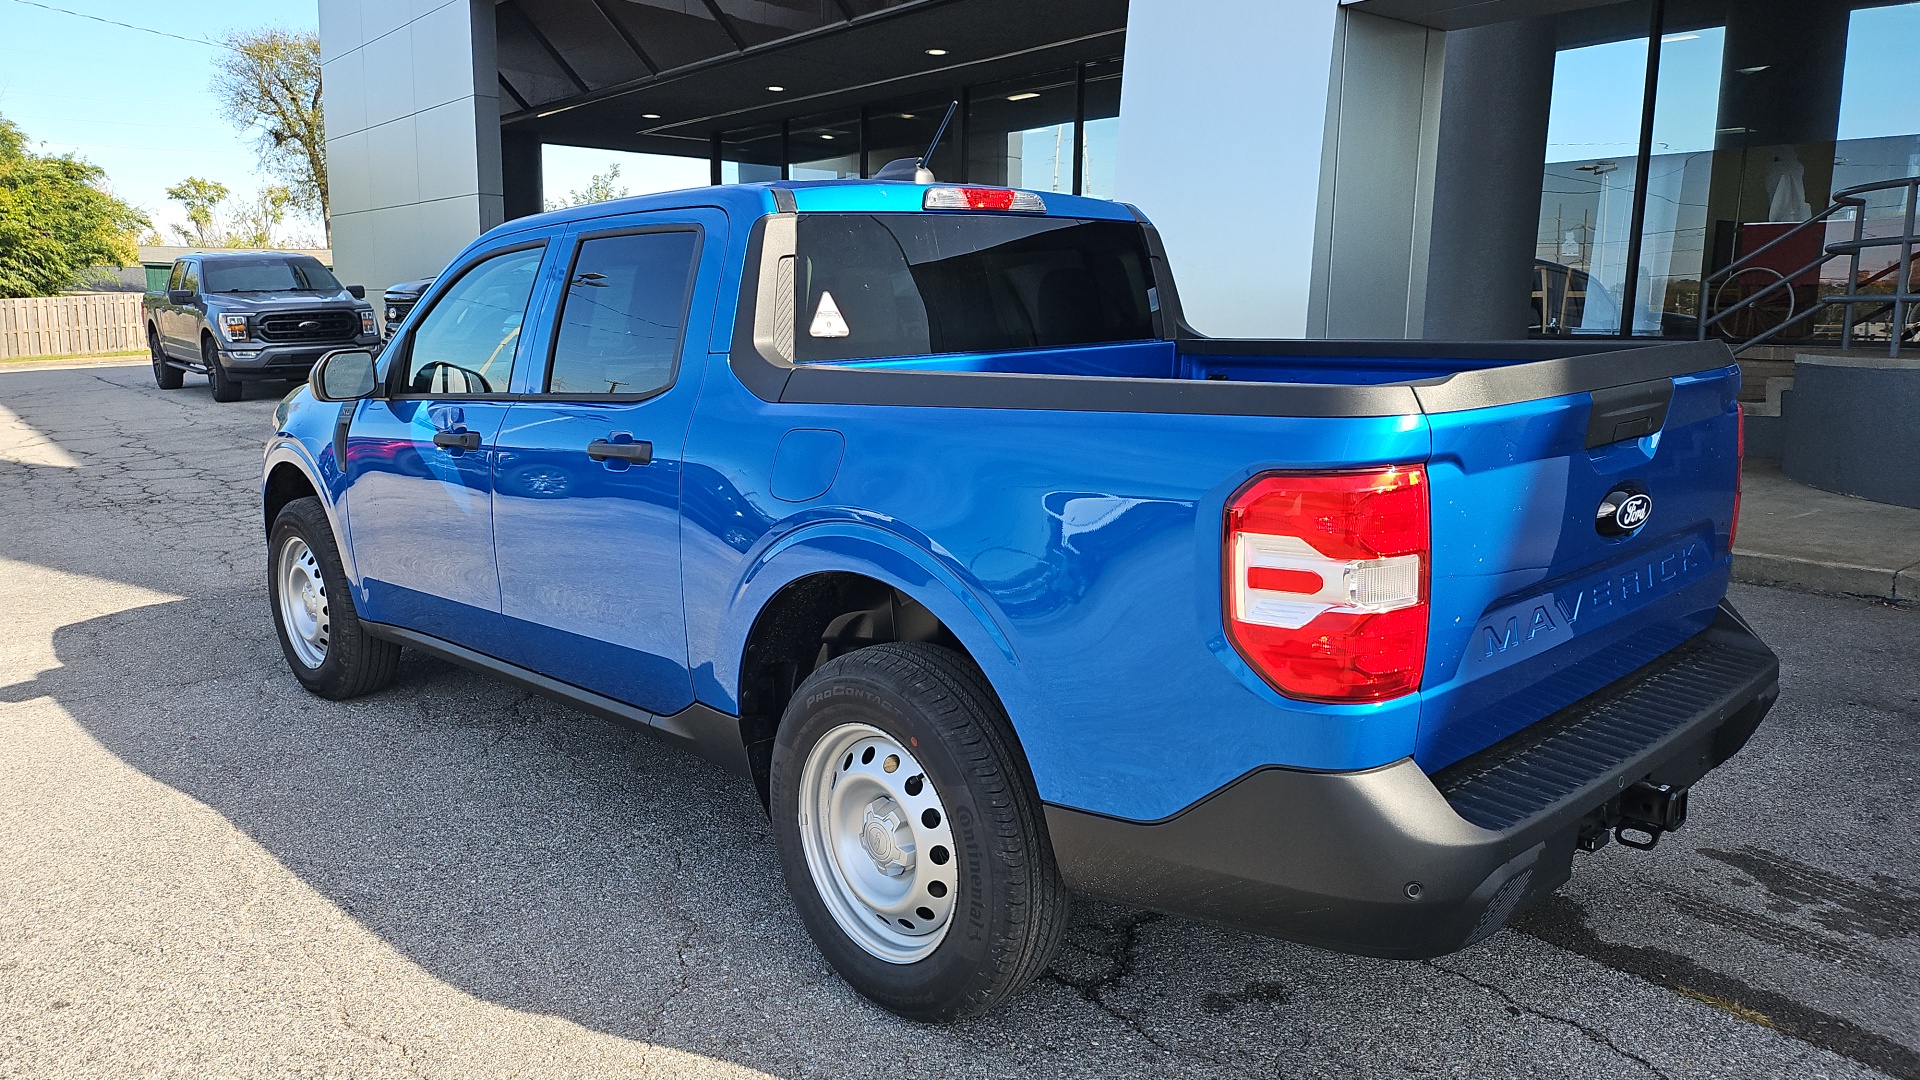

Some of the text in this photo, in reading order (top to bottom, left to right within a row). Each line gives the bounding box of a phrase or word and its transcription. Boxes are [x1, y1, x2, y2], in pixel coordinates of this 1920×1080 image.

[1623, 499, 1648, 525] Ford
[1483, 543, 1697, 658] MAVERICK
[956, 805, 984, 929] Continental
